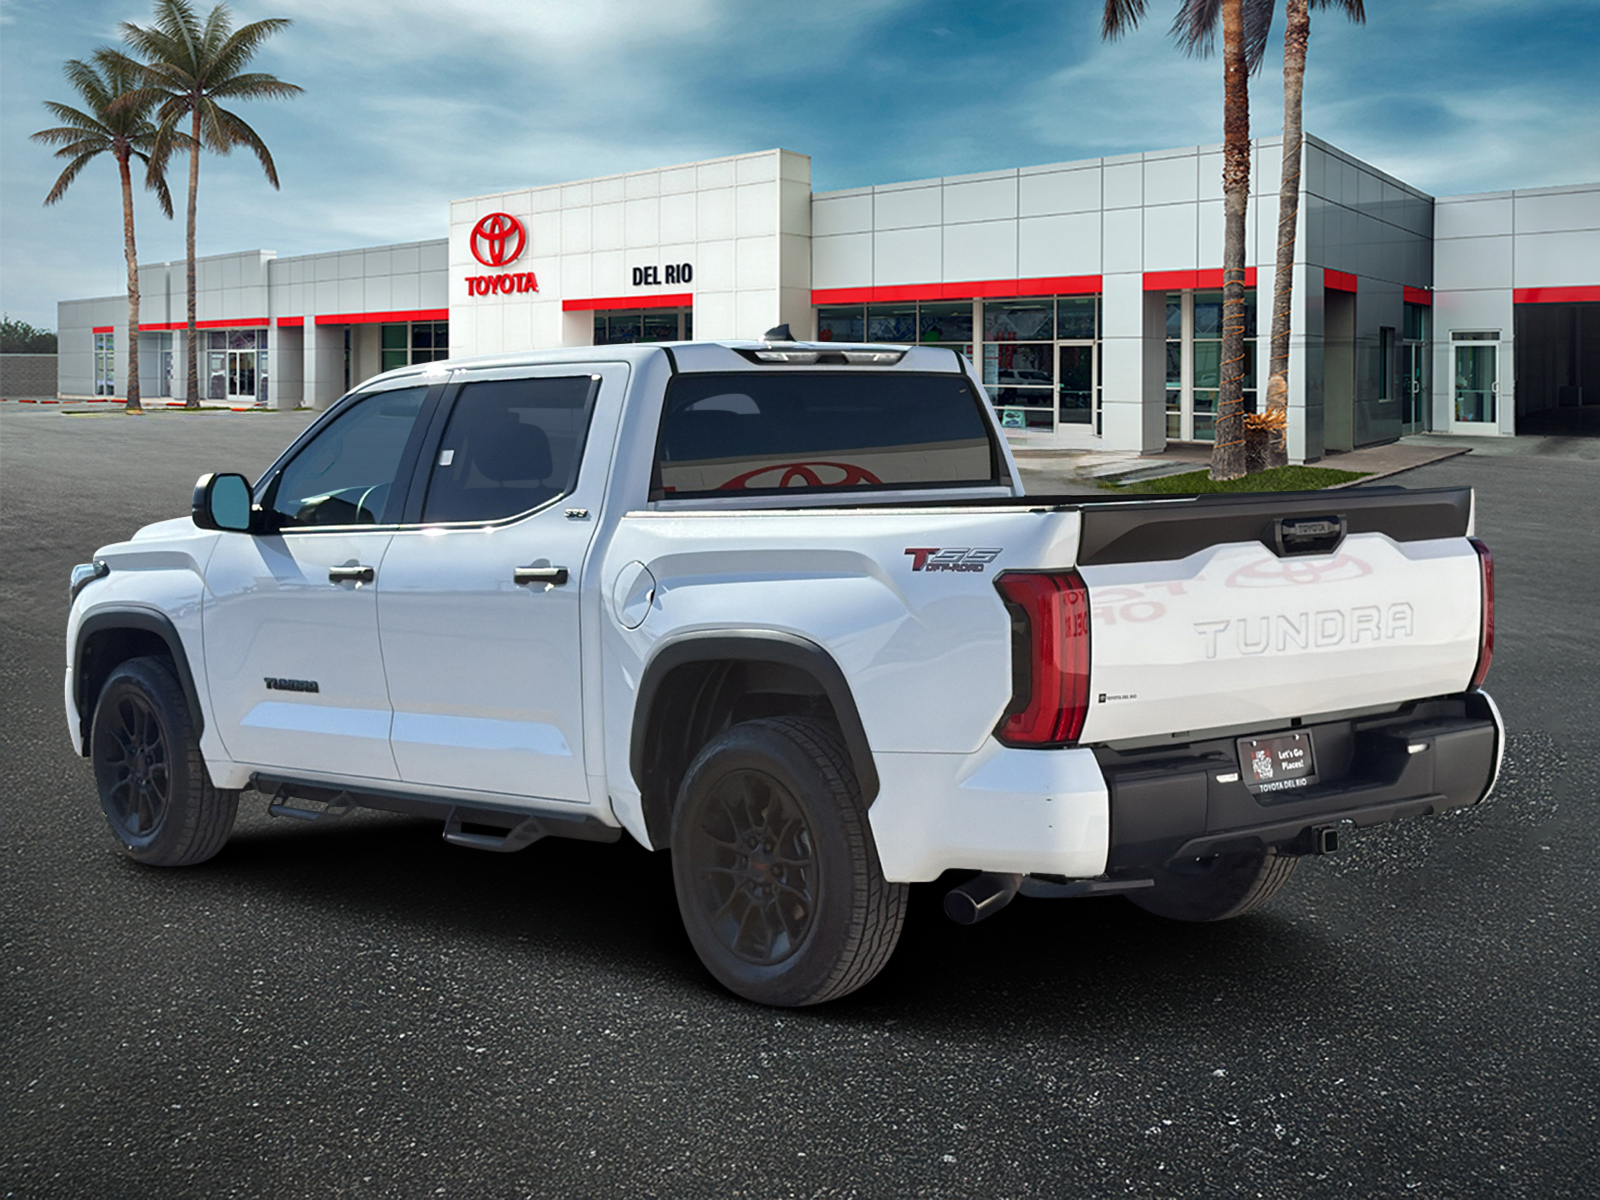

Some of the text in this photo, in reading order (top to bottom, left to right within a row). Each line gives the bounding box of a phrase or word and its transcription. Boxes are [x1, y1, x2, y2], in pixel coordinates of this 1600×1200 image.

[465, 272, 538, 296] TOYOTA
[632, 263, 693, 286] DEL RIO
[1193, 602, 1414, 659] TUNDRA
[1278, 748, 1304, 760] Let's Go
[1281, 759, 1304, 771] Places!
[1259, 778, 1307, 793] TOYOTA DEL RIO
